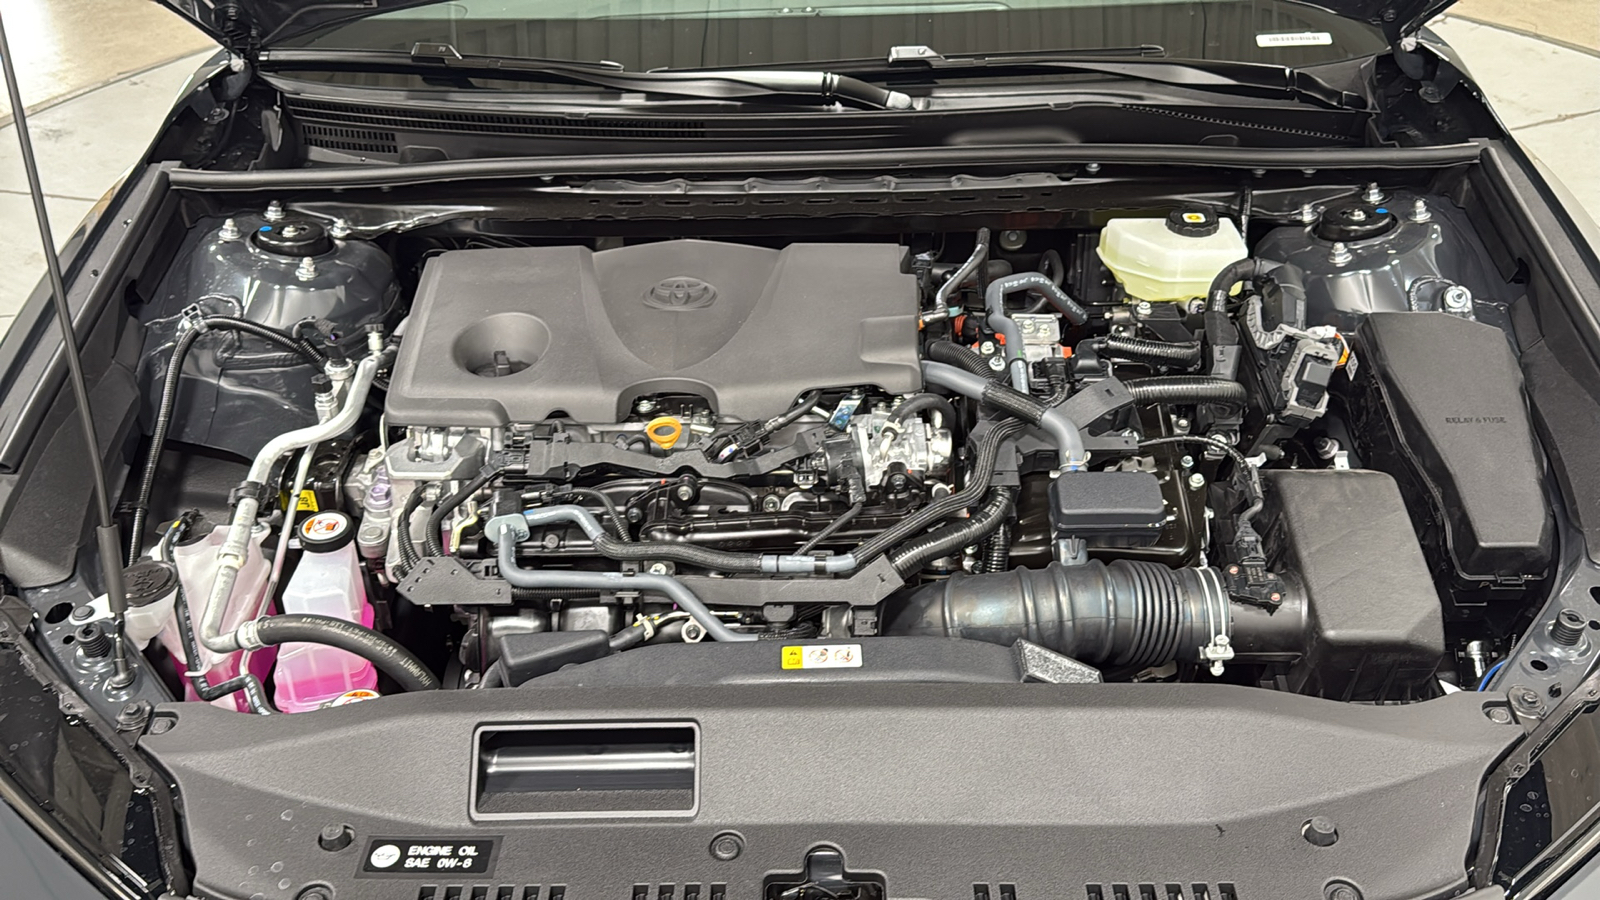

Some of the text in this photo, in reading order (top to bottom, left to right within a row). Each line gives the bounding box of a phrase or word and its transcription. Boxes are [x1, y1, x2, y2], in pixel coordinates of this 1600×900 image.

[1445, 416, 1473, 424] RELAY
[1482, 416, 1507, 424] FUSE
[407, 845, 479, 856] ENGINE OIL
[403, 857, 473, 868] SAE 0W-8
